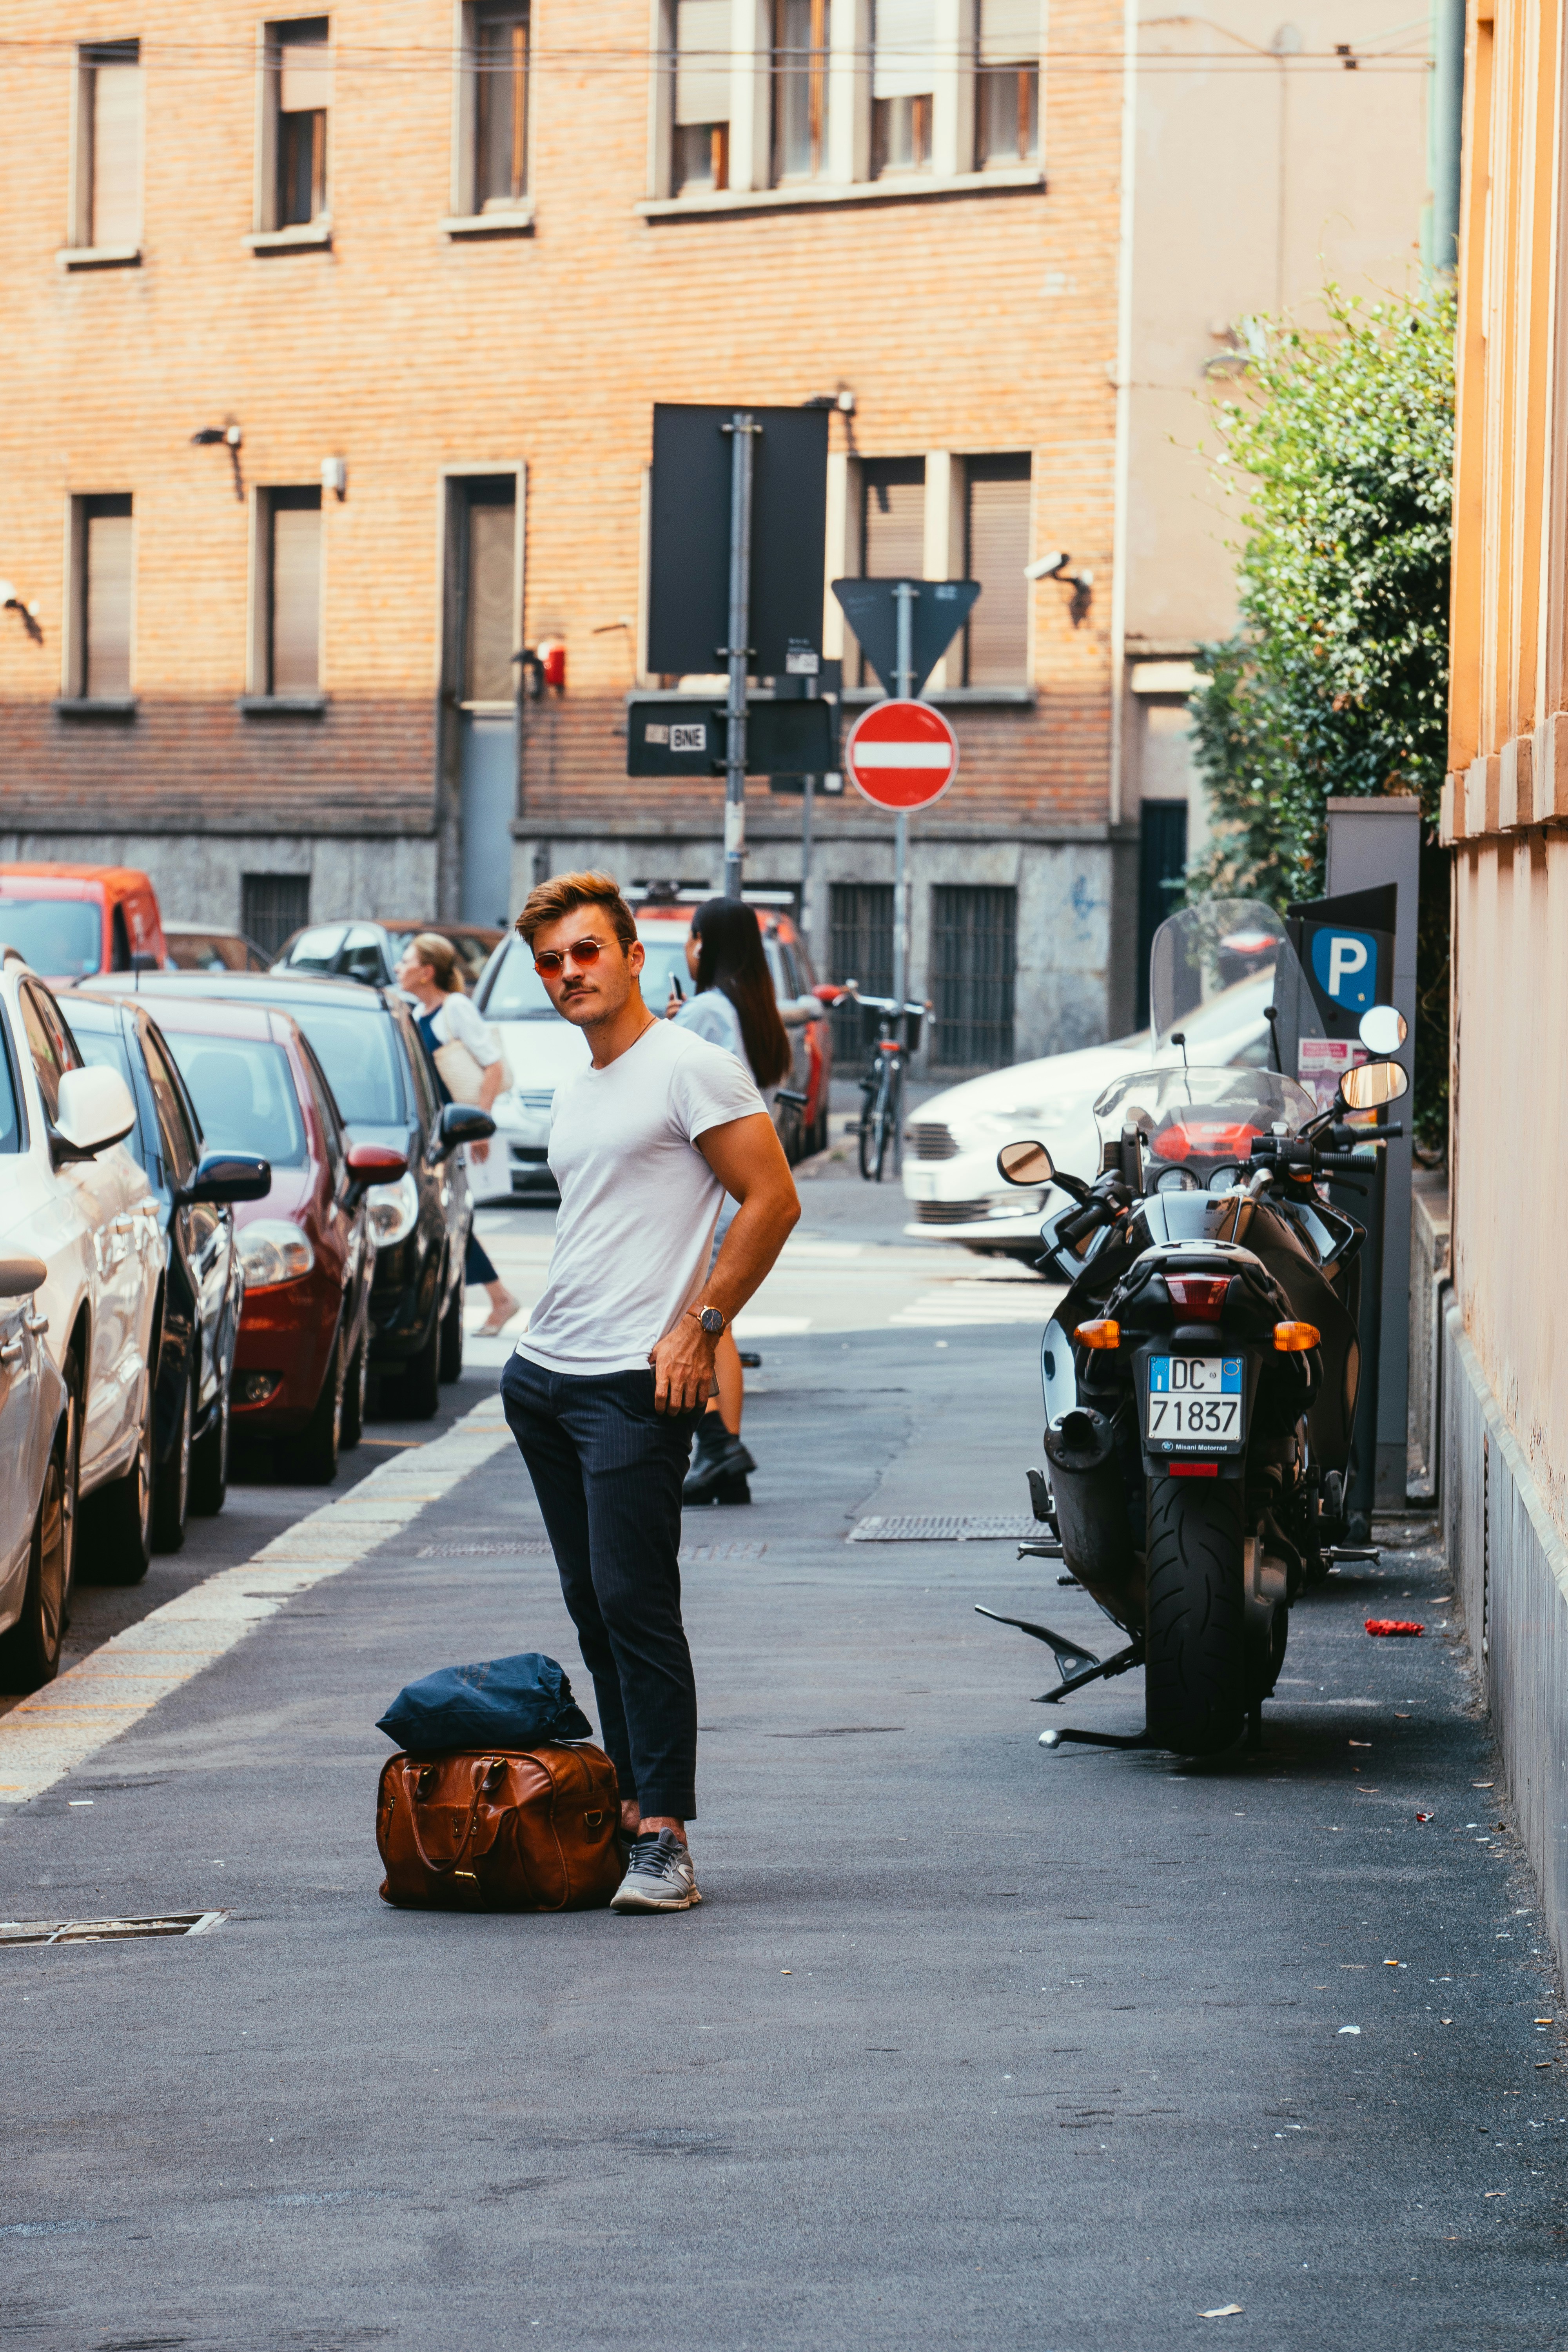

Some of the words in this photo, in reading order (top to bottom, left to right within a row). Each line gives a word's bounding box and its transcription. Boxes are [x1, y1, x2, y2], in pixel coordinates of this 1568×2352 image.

[674, 729, 701, 747] BNE
[1328, 937, 1367, 996] P
[1172, 1359, 1205, 1390] DC
[1152, 1401, 1238, 1432] 71837
